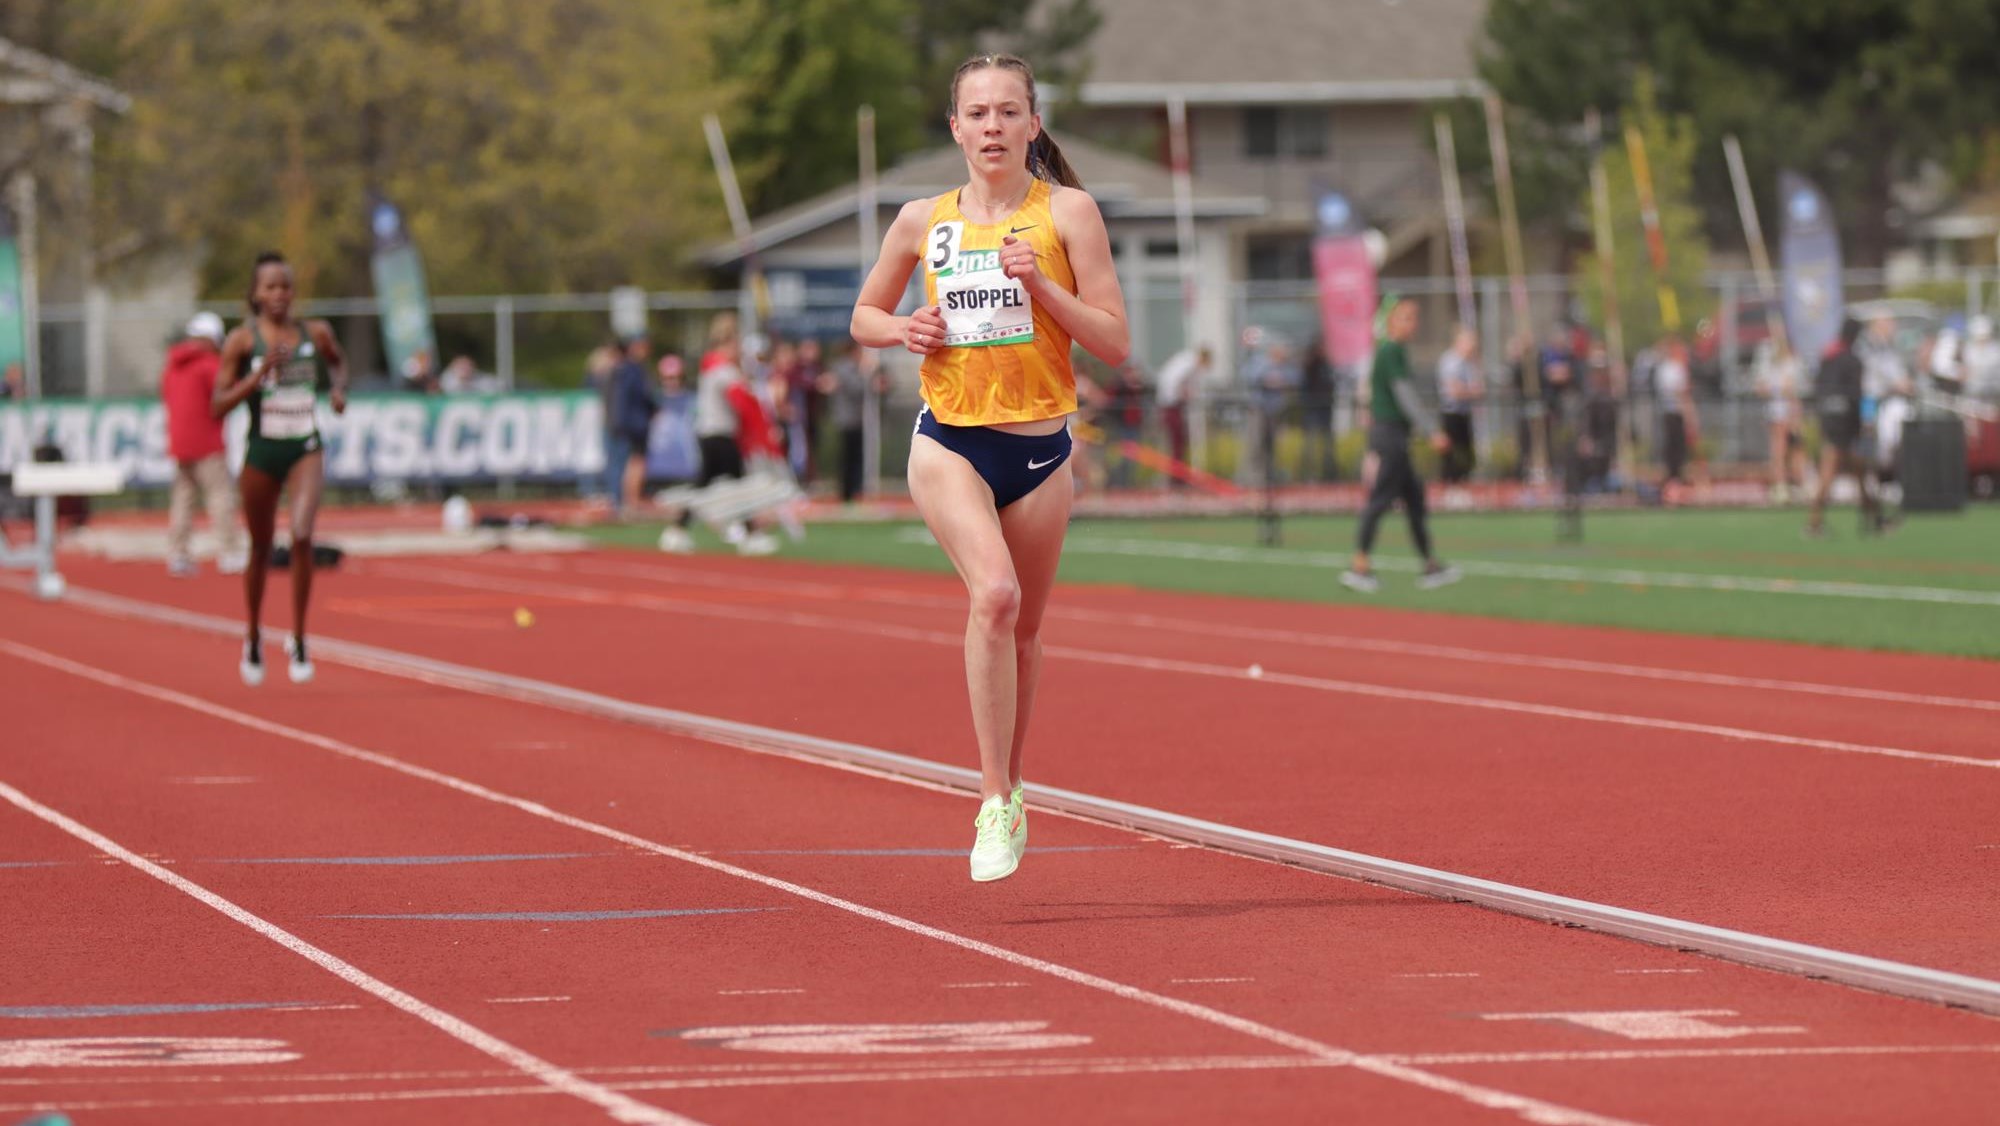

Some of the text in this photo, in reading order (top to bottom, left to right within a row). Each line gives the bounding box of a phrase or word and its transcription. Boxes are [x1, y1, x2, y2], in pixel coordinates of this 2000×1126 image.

[933, 225, 954, 269] 3
[954, 251, 1000, 277] gna
[946, 288, 1023, 310] STOPPEL
